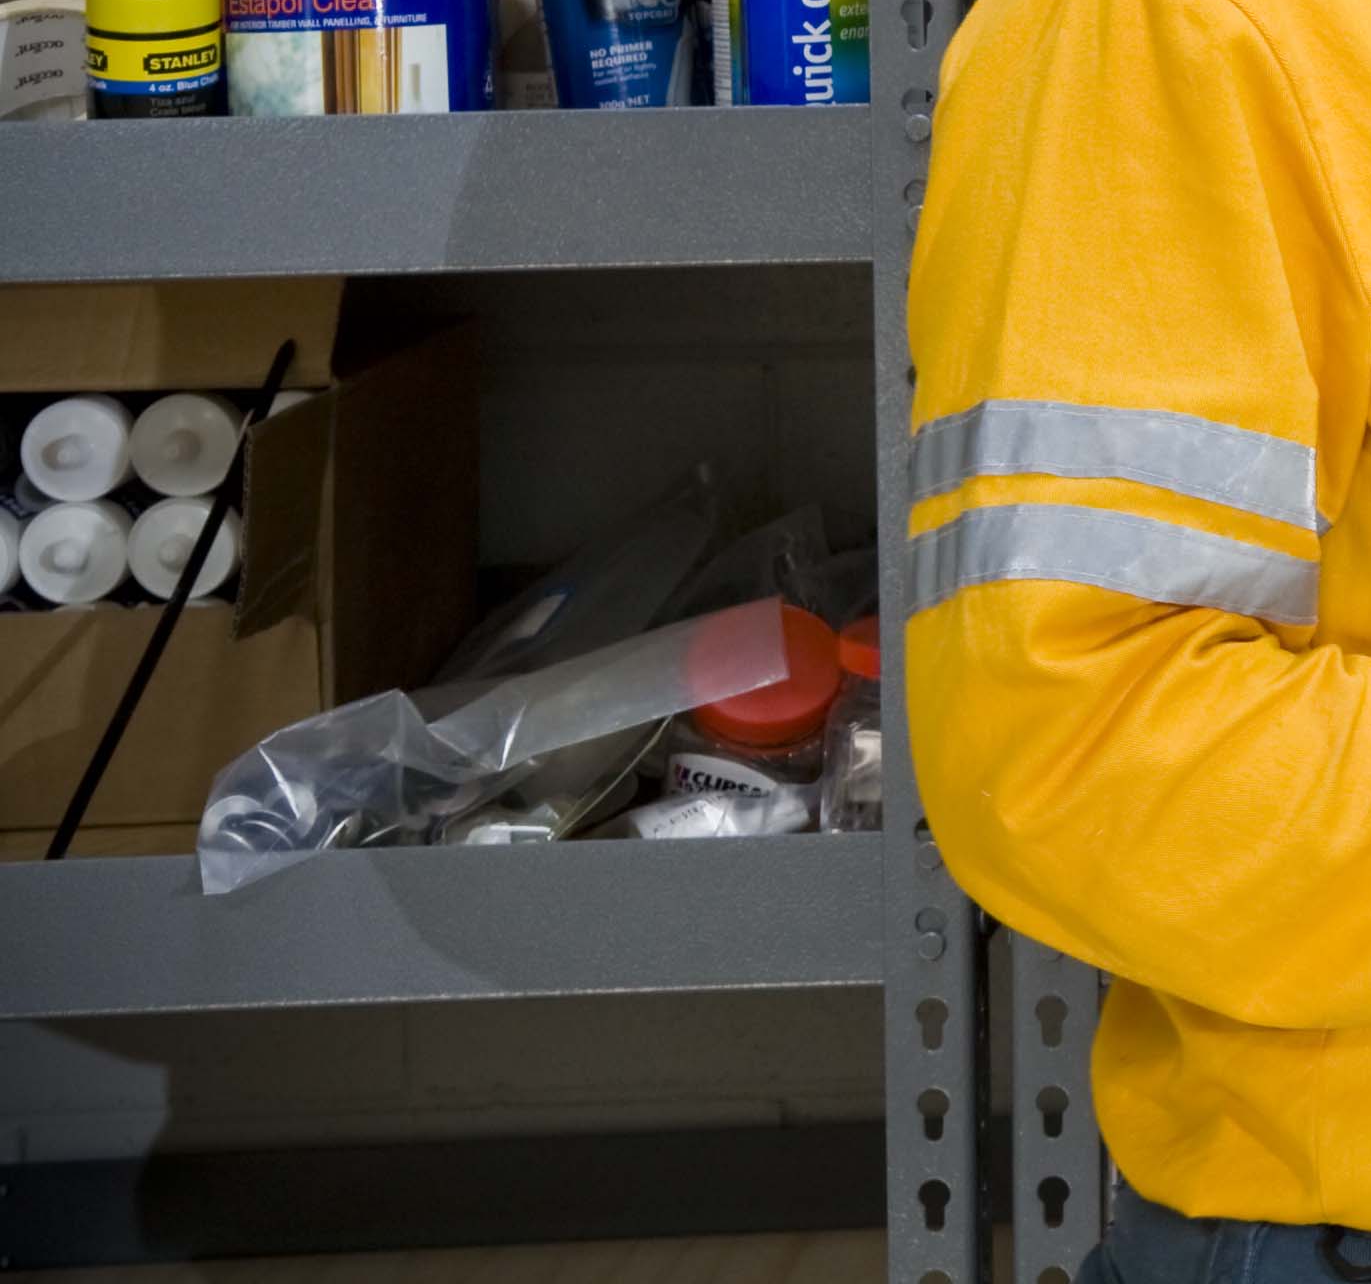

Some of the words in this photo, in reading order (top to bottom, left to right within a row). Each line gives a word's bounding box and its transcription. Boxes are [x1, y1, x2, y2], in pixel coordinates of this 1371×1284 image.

[267, 19, 296, 28] TIMBER
[298, 18, 320, 28] WALL
[323, 17, 373, 28] PANELLING,
[150, 48, 215, 70] STANLEY
[590, 49, 606, 59] NO
[609, 41, 653, 55] PRIMER
[791, 19, 835, 107] uick
[149, 83, 155, 92] 4
[159, 84, 174, 92] oz.
[177, 80, 198, 91] Blue
